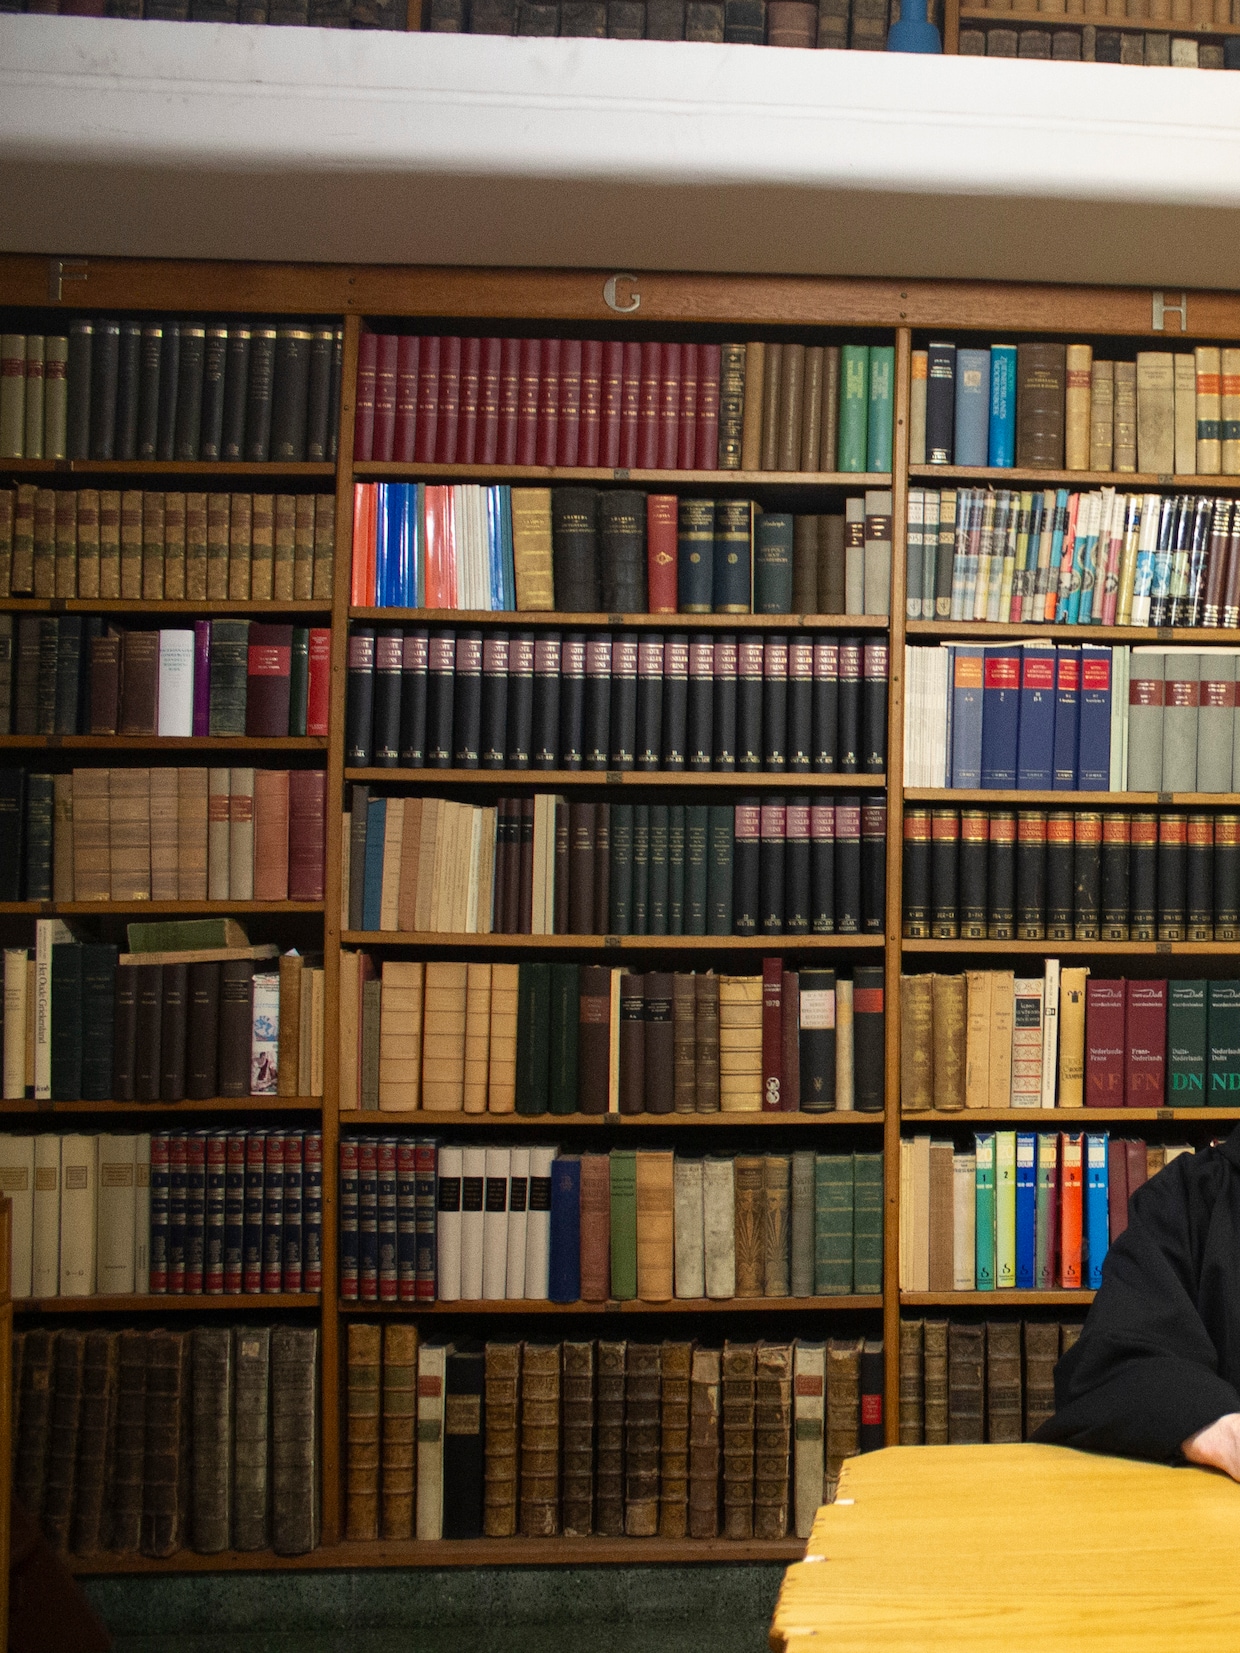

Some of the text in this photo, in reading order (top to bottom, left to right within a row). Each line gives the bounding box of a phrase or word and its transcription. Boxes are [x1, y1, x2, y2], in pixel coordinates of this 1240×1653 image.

[47, 259, 88, 301] F
[603, 273, 640, 313] G
[1152, 291, 1187, 331] H
[38, 963, 47, 1044] Het Oude Griekenland
[1131, 1073, 1161, 1090] FN
[1172, 1072, 1203, 1090] DN
